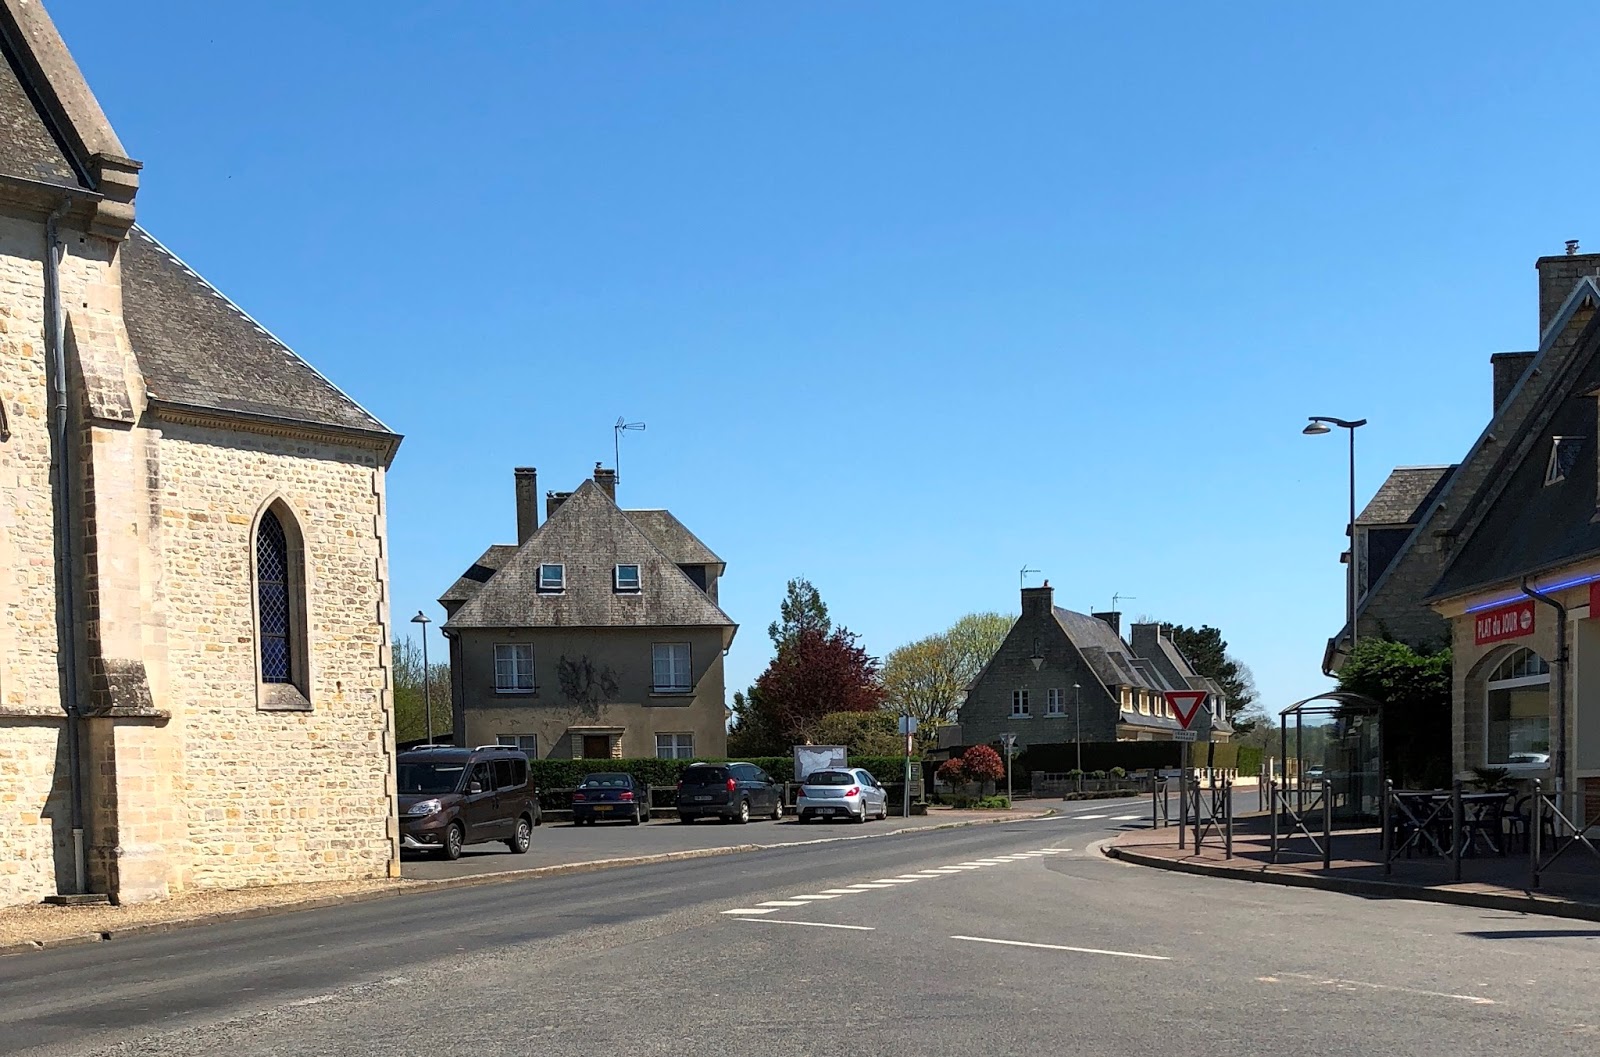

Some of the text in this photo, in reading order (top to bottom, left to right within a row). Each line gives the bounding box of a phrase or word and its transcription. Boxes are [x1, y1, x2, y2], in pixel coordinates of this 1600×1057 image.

[1477, 611, 1518, 639] PLAT du JOUR
